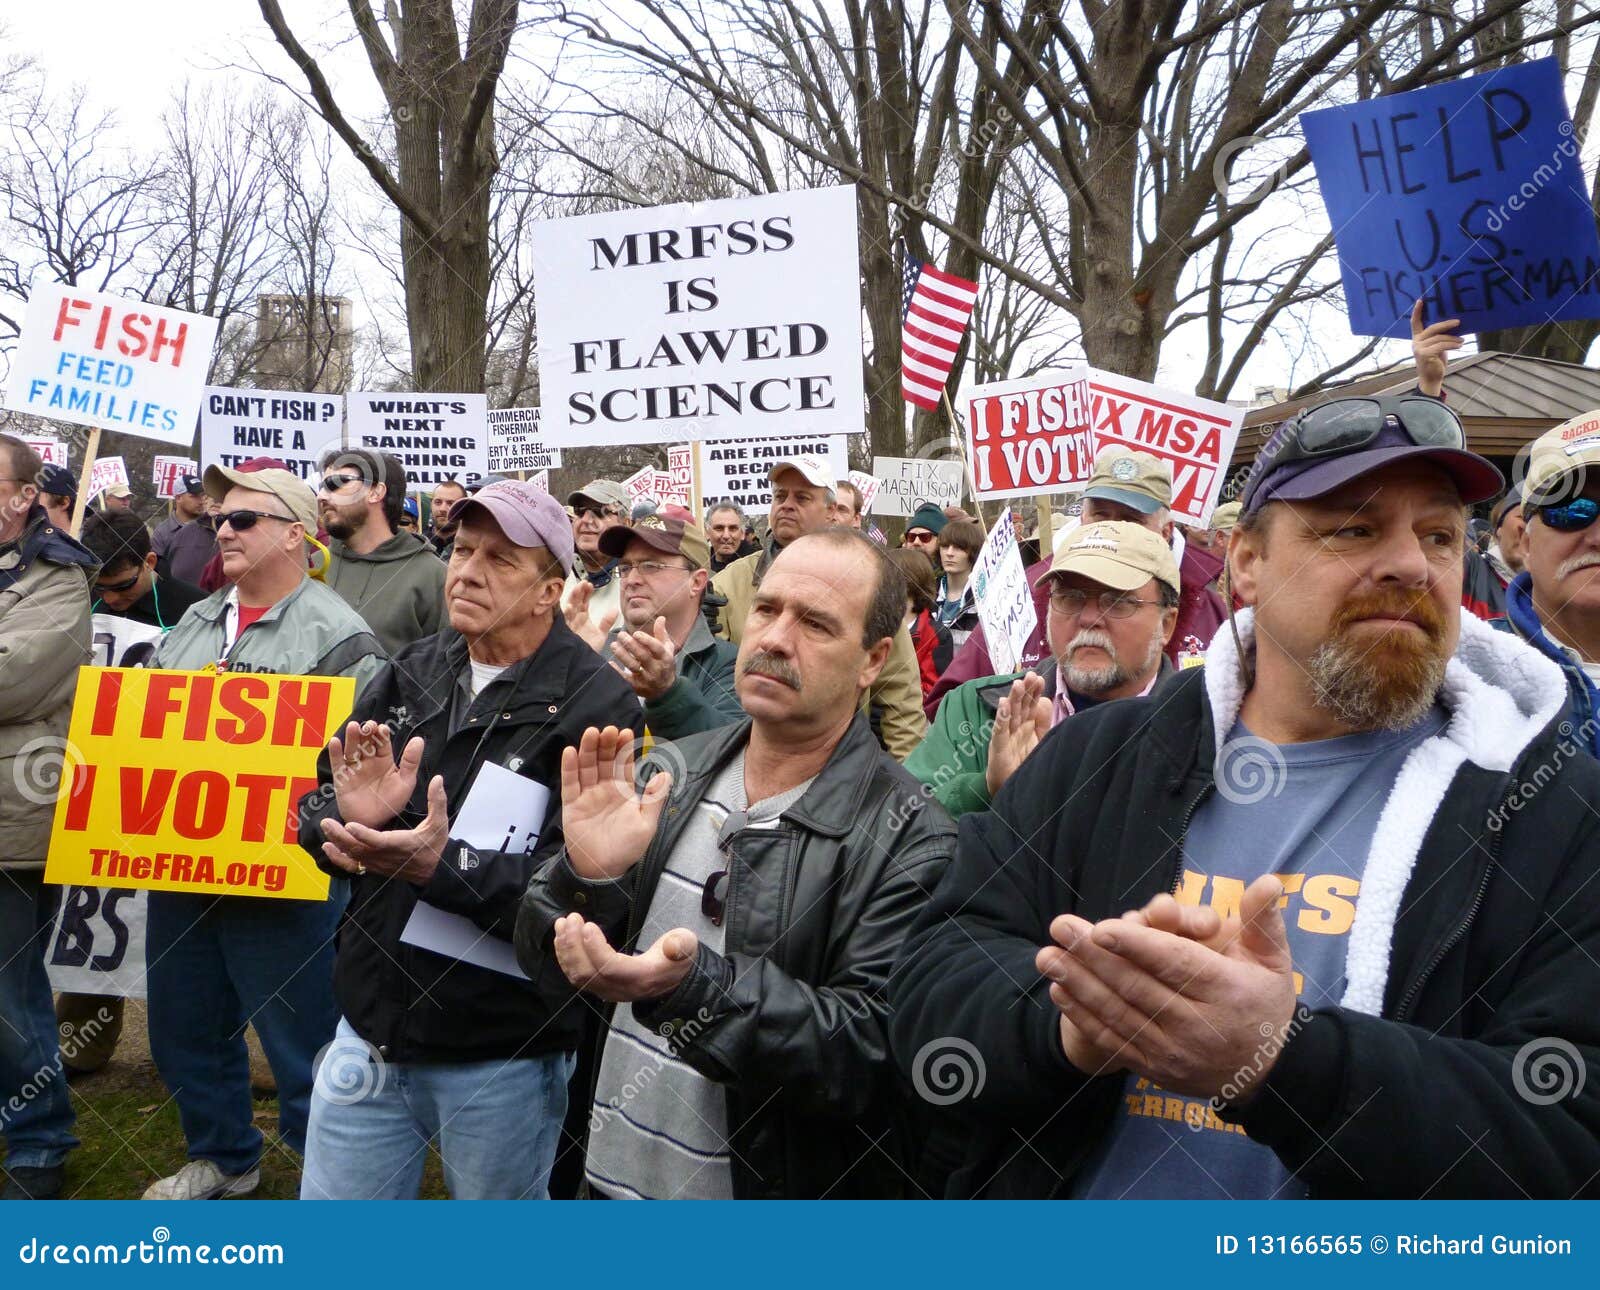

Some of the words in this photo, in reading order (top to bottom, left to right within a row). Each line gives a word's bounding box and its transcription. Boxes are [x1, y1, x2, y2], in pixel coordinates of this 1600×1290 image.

[1352, 88, 1532, 195] HELP
[589, 216, 795, 271] MRFSS
[1395, 201, 1522, 272] U.S.
[664, 277, 720, 315] IS
[53, 297, 188, 367] FISH
[570, 322, 829, 375] FLAWED
[57, 352, 134, 388] FEED
[29, 380, 178, 431] FAMILIES
[210, 395, 266, 418] CAN'T
[271, 399, 316, 421] FISH
[322, 402, 335, 422] ?
[369, 401, 466, 415] WHAT'S
[568, 375, 836, 426] SCIENCE
[385, 419, 445, 432] NEXT
[487, 409, 540, 424] OMMERCIA
[492, 422, 539, 436] FISHERMAN
[973, 399, 990, 441] I
[234, 426, 283, 448] HAVE
[292, 430, 306, 450] A
[1135, 408, 1221, 464] MSA
[1561, 419, 1600, 440] BACKD
[363, 436, 476, 450] BANNING
[488, 445, 509, 457] ERTY
[512, 445, 518, 456] &
[710, 448, 748, 461] ARE
[753, 443, 829, 458] FAILING
[504, 455, 552, 469] OPPRESSION
[670, 454, 683, 467] FIX
[724, 463, 773, 475] BECA
[901, 462, 938, 479] FIX
[975, 445, 994, 491] I
[405, 471, 459, 484] ALLY
[728, 479, 752, 490] OF
[878, 478, 958, 498] MAGNUSON
[91, 672, 123, 736] I
[140, 674, 332, 748] FISH
[64, 764, 97, 832] I
[89, 849, 287, 892] TheFRA.org
